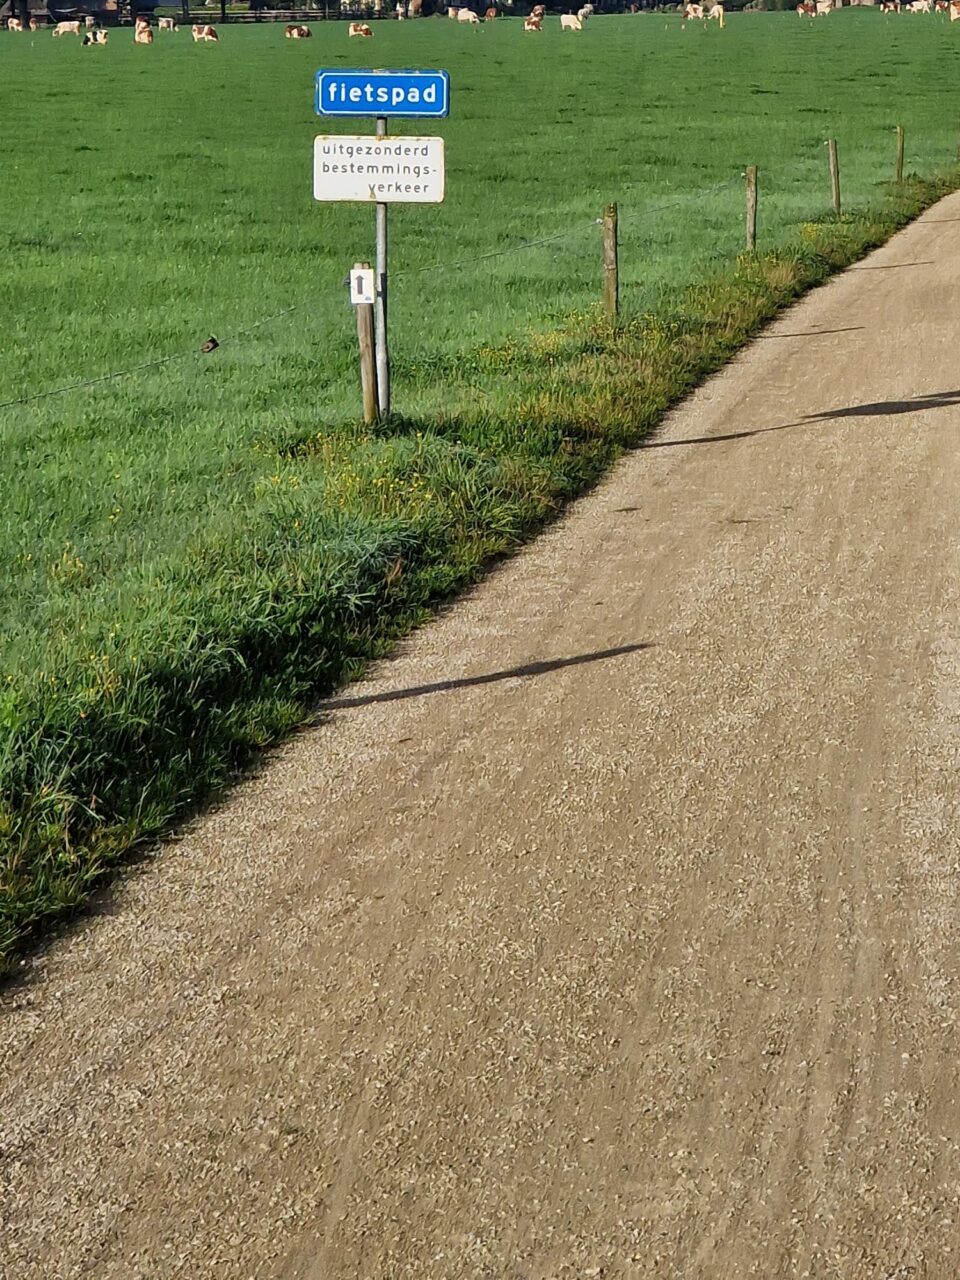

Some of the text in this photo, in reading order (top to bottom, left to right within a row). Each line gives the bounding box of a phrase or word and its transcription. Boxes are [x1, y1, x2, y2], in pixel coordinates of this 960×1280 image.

[328, 83, 436, 105] fietspad
[322, 143, 428, 158] uitgezonderd
[322, 162, 436, 177] bestemmings-
[368, 182, 429, 193] verkeer
